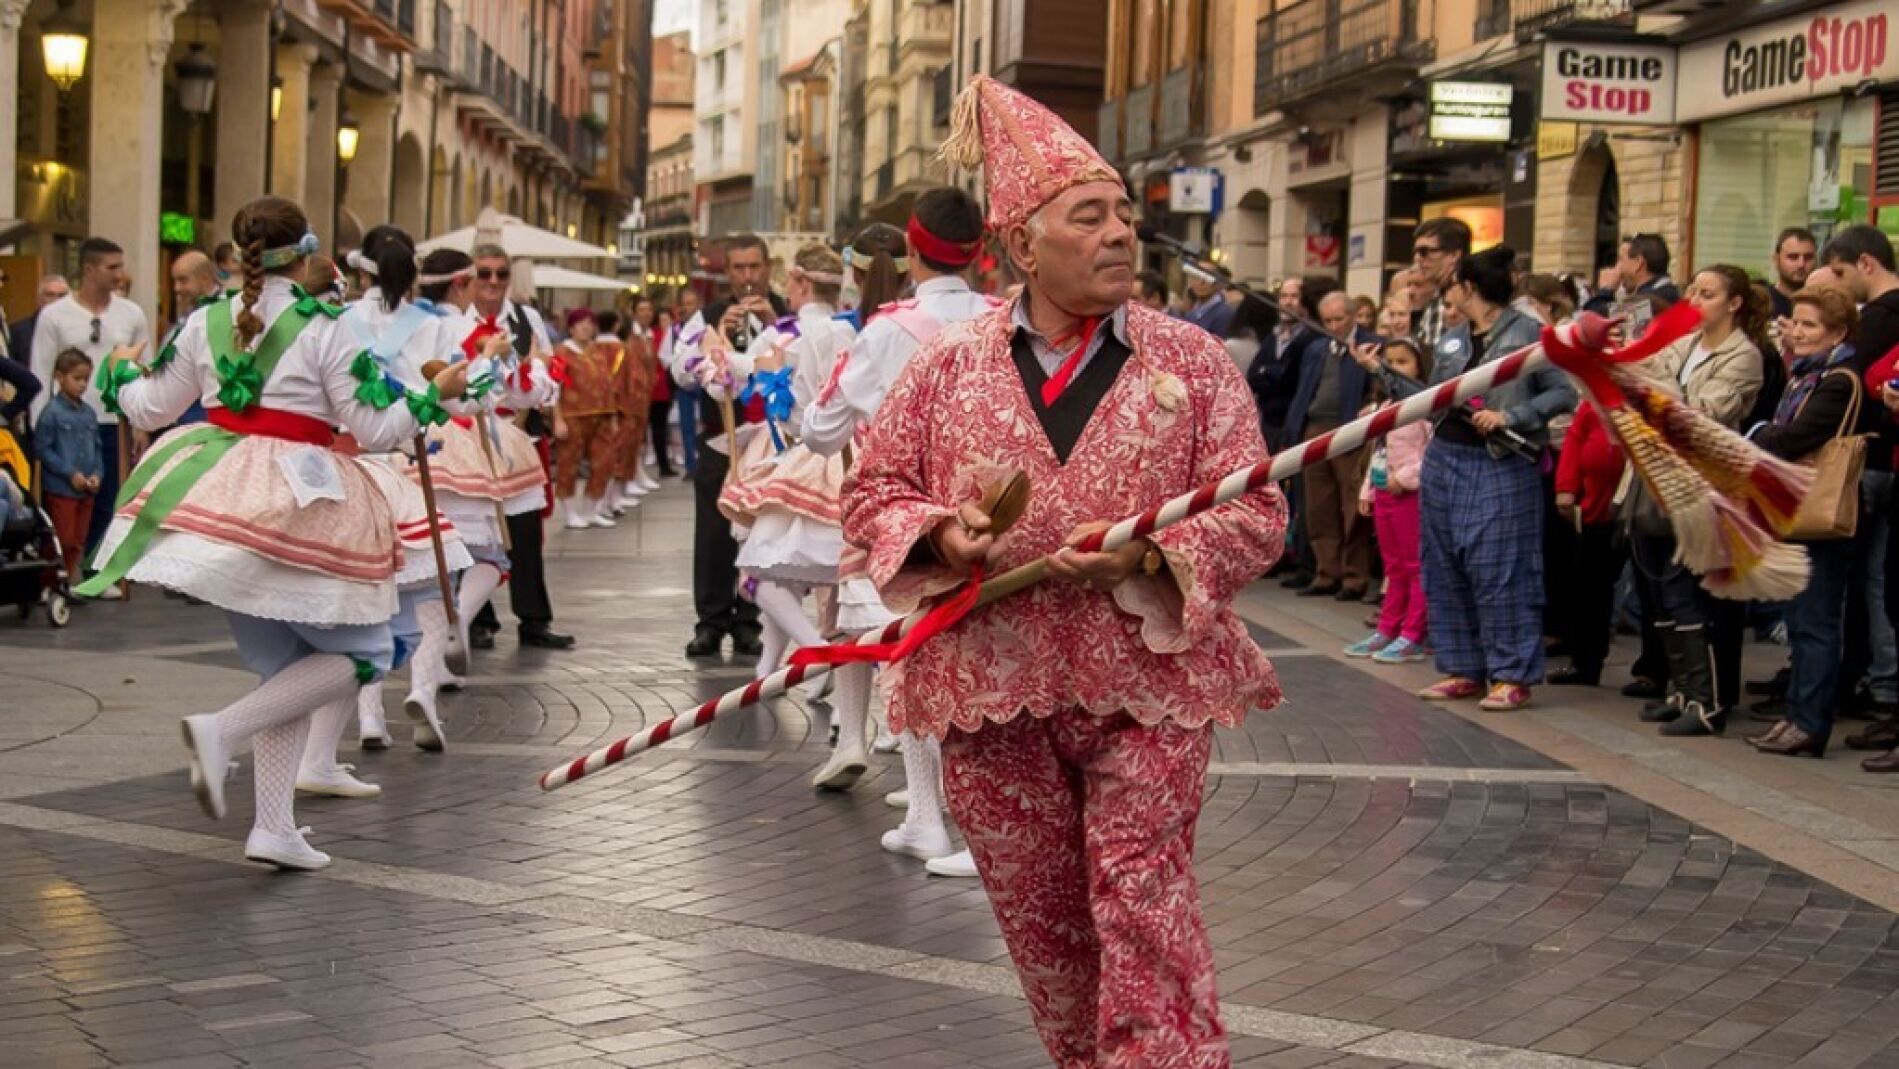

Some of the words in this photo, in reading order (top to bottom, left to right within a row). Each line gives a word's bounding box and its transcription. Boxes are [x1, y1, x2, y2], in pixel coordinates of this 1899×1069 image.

[1557, 47, 1662, 81] Game
[1723, 12, 1887, 98] GameStop
[1565, 80, 1651, 115] Stop
